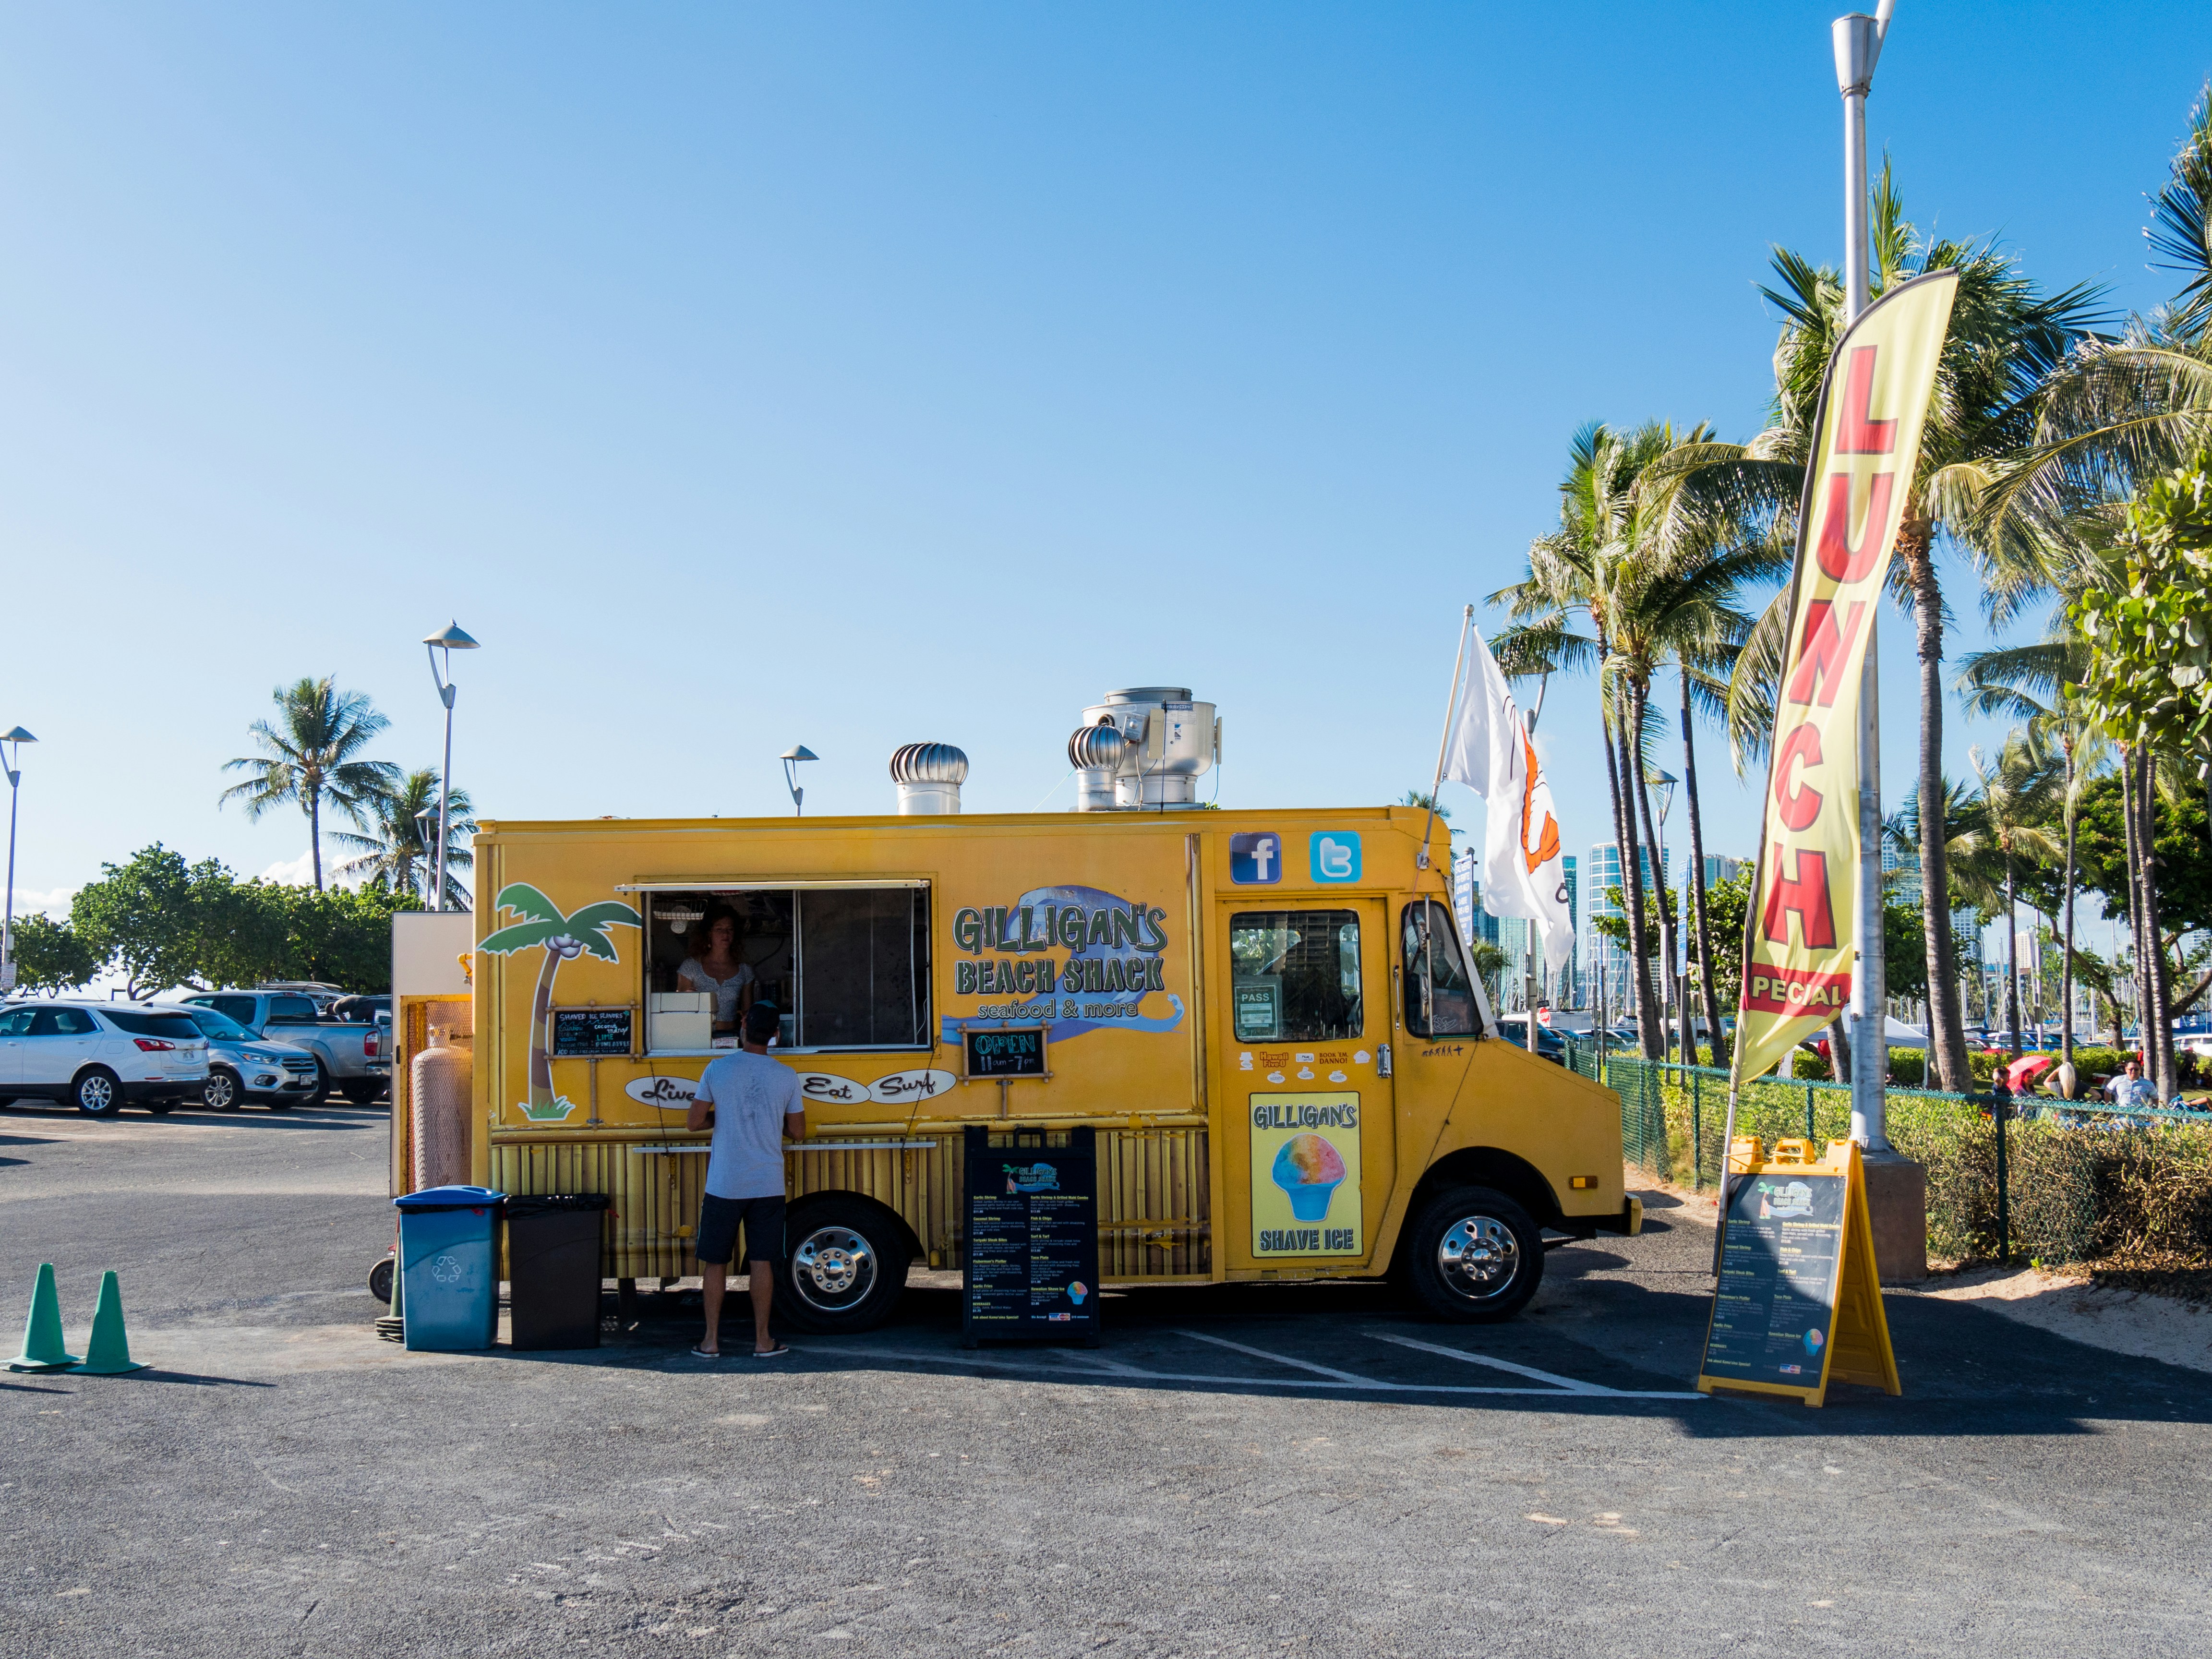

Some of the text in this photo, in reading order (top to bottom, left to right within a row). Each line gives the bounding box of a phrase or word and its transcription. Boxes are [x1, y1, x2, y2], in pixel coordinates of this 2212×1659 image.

[1764, 343, 1899, 951] LUNCH
[1251, 837, 1353, 880] f t
[953, 902, 1167, 954] GILLIGAN'S
[955, 957, 1165, 994] BEACH SHACK
[1242, 993, 1269, 1002] PASS
[1752, 975, 1842, 1007] PECIAL
[559, 1013, 586, 1022] SHAVED
[977, 999, 1138, 1019] seafood & more
[1540, 1011, 1549, 1020] STOP
[975, 1035, 1035, 1055] OPEN
[1260, 1051, 1289, 1060] Hawaii
[641, 1079, 696, 1101] Live
[804, 1077, 852, 1101] Eat
[879, 1073, 936, 1096] Surf
[1252, 1103, 1357, 1130] GILLIGAN'S
[1259, 1228, 1354, 1251] SHAVE ICE
